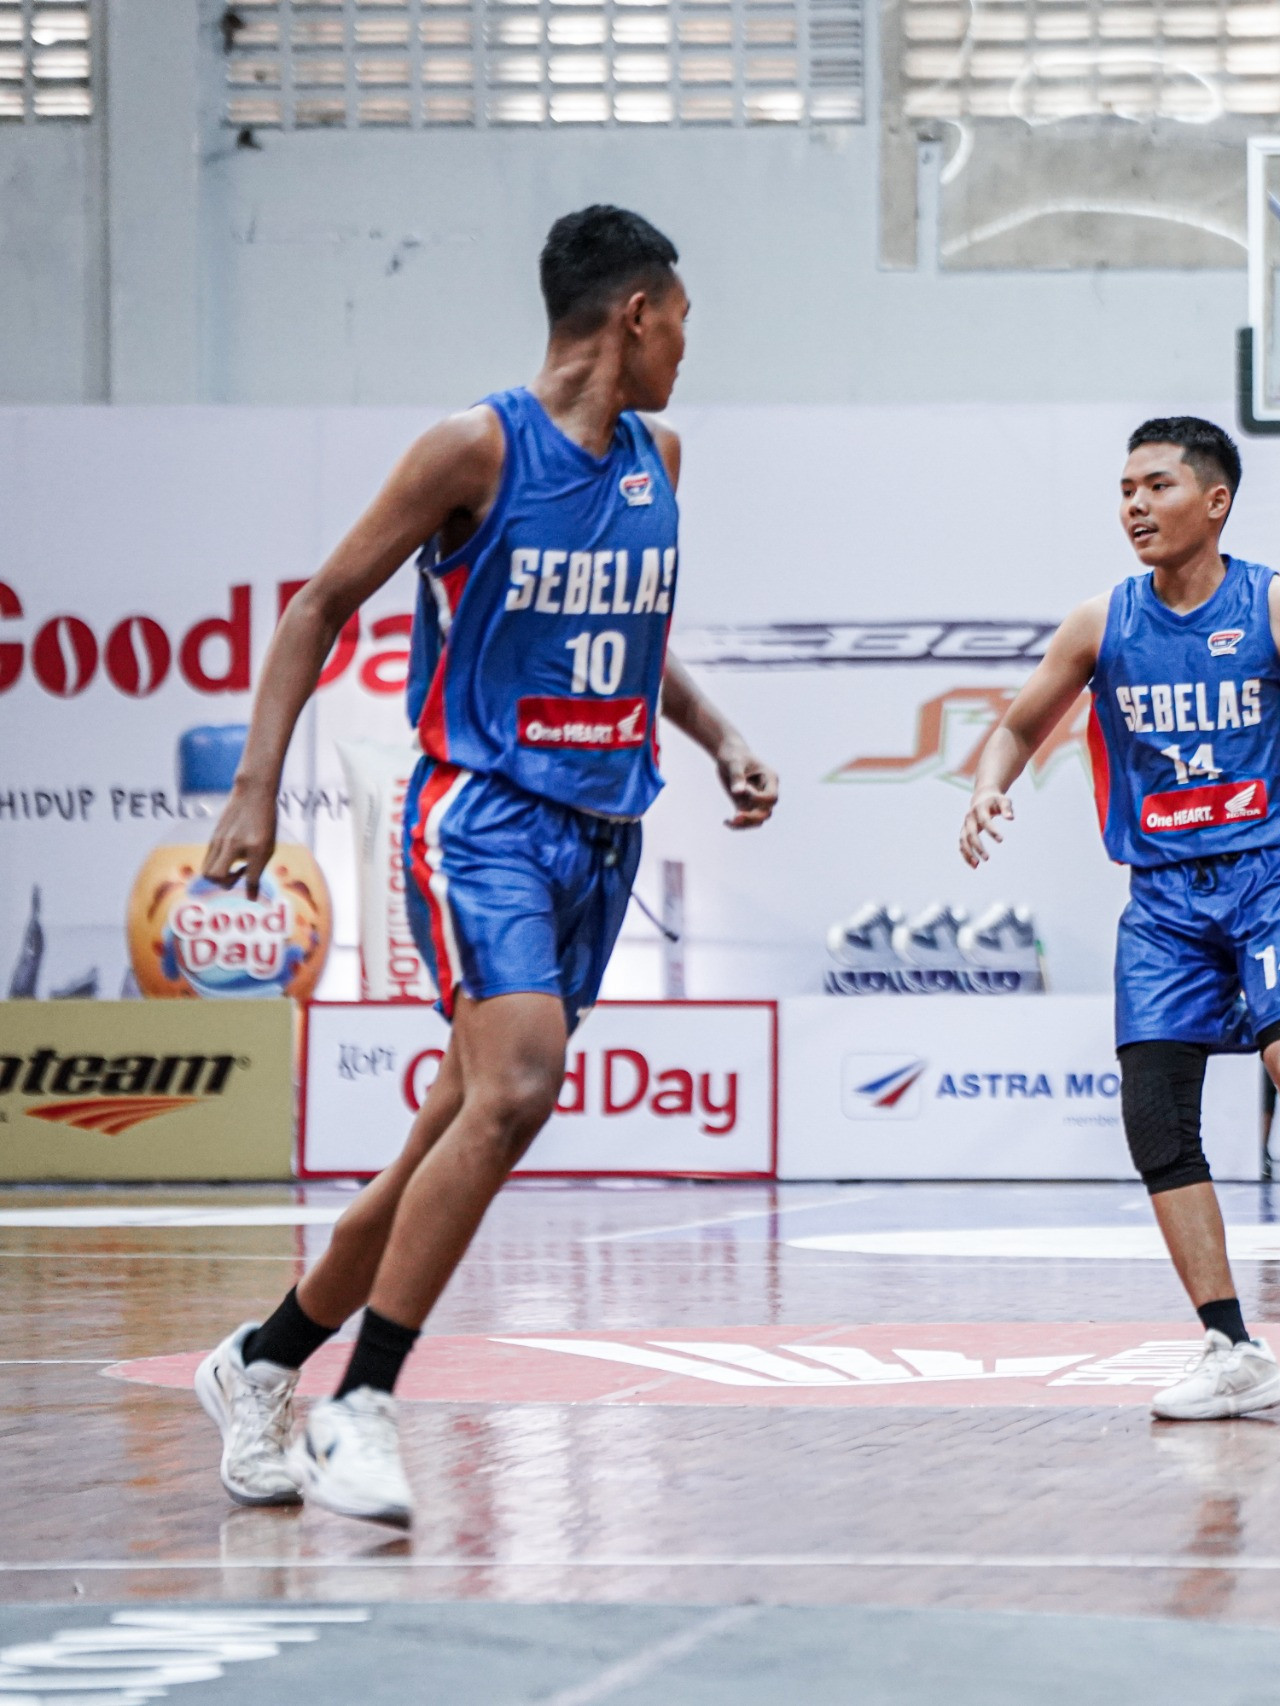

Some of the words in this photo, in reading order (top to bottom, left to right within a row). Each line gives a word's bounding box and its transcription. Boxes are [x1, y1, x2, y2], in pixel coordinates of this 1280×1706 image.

[565, 631, 626, 696] 10
[1115, 678, 1262, 734] SEBELAS
[526, 719, 562, 742] One
[1161, 743, 1224, 785] 14
[1146, 812, 1173, 829] One
[1173, 805, 1215, 827] HEART.
[176, 904, 288, 935] Good
[189, 940, 278, 977] Day
[601, 1048, 739, 1136] Day
[935, 1072, 1055, 1099] ASTRA
